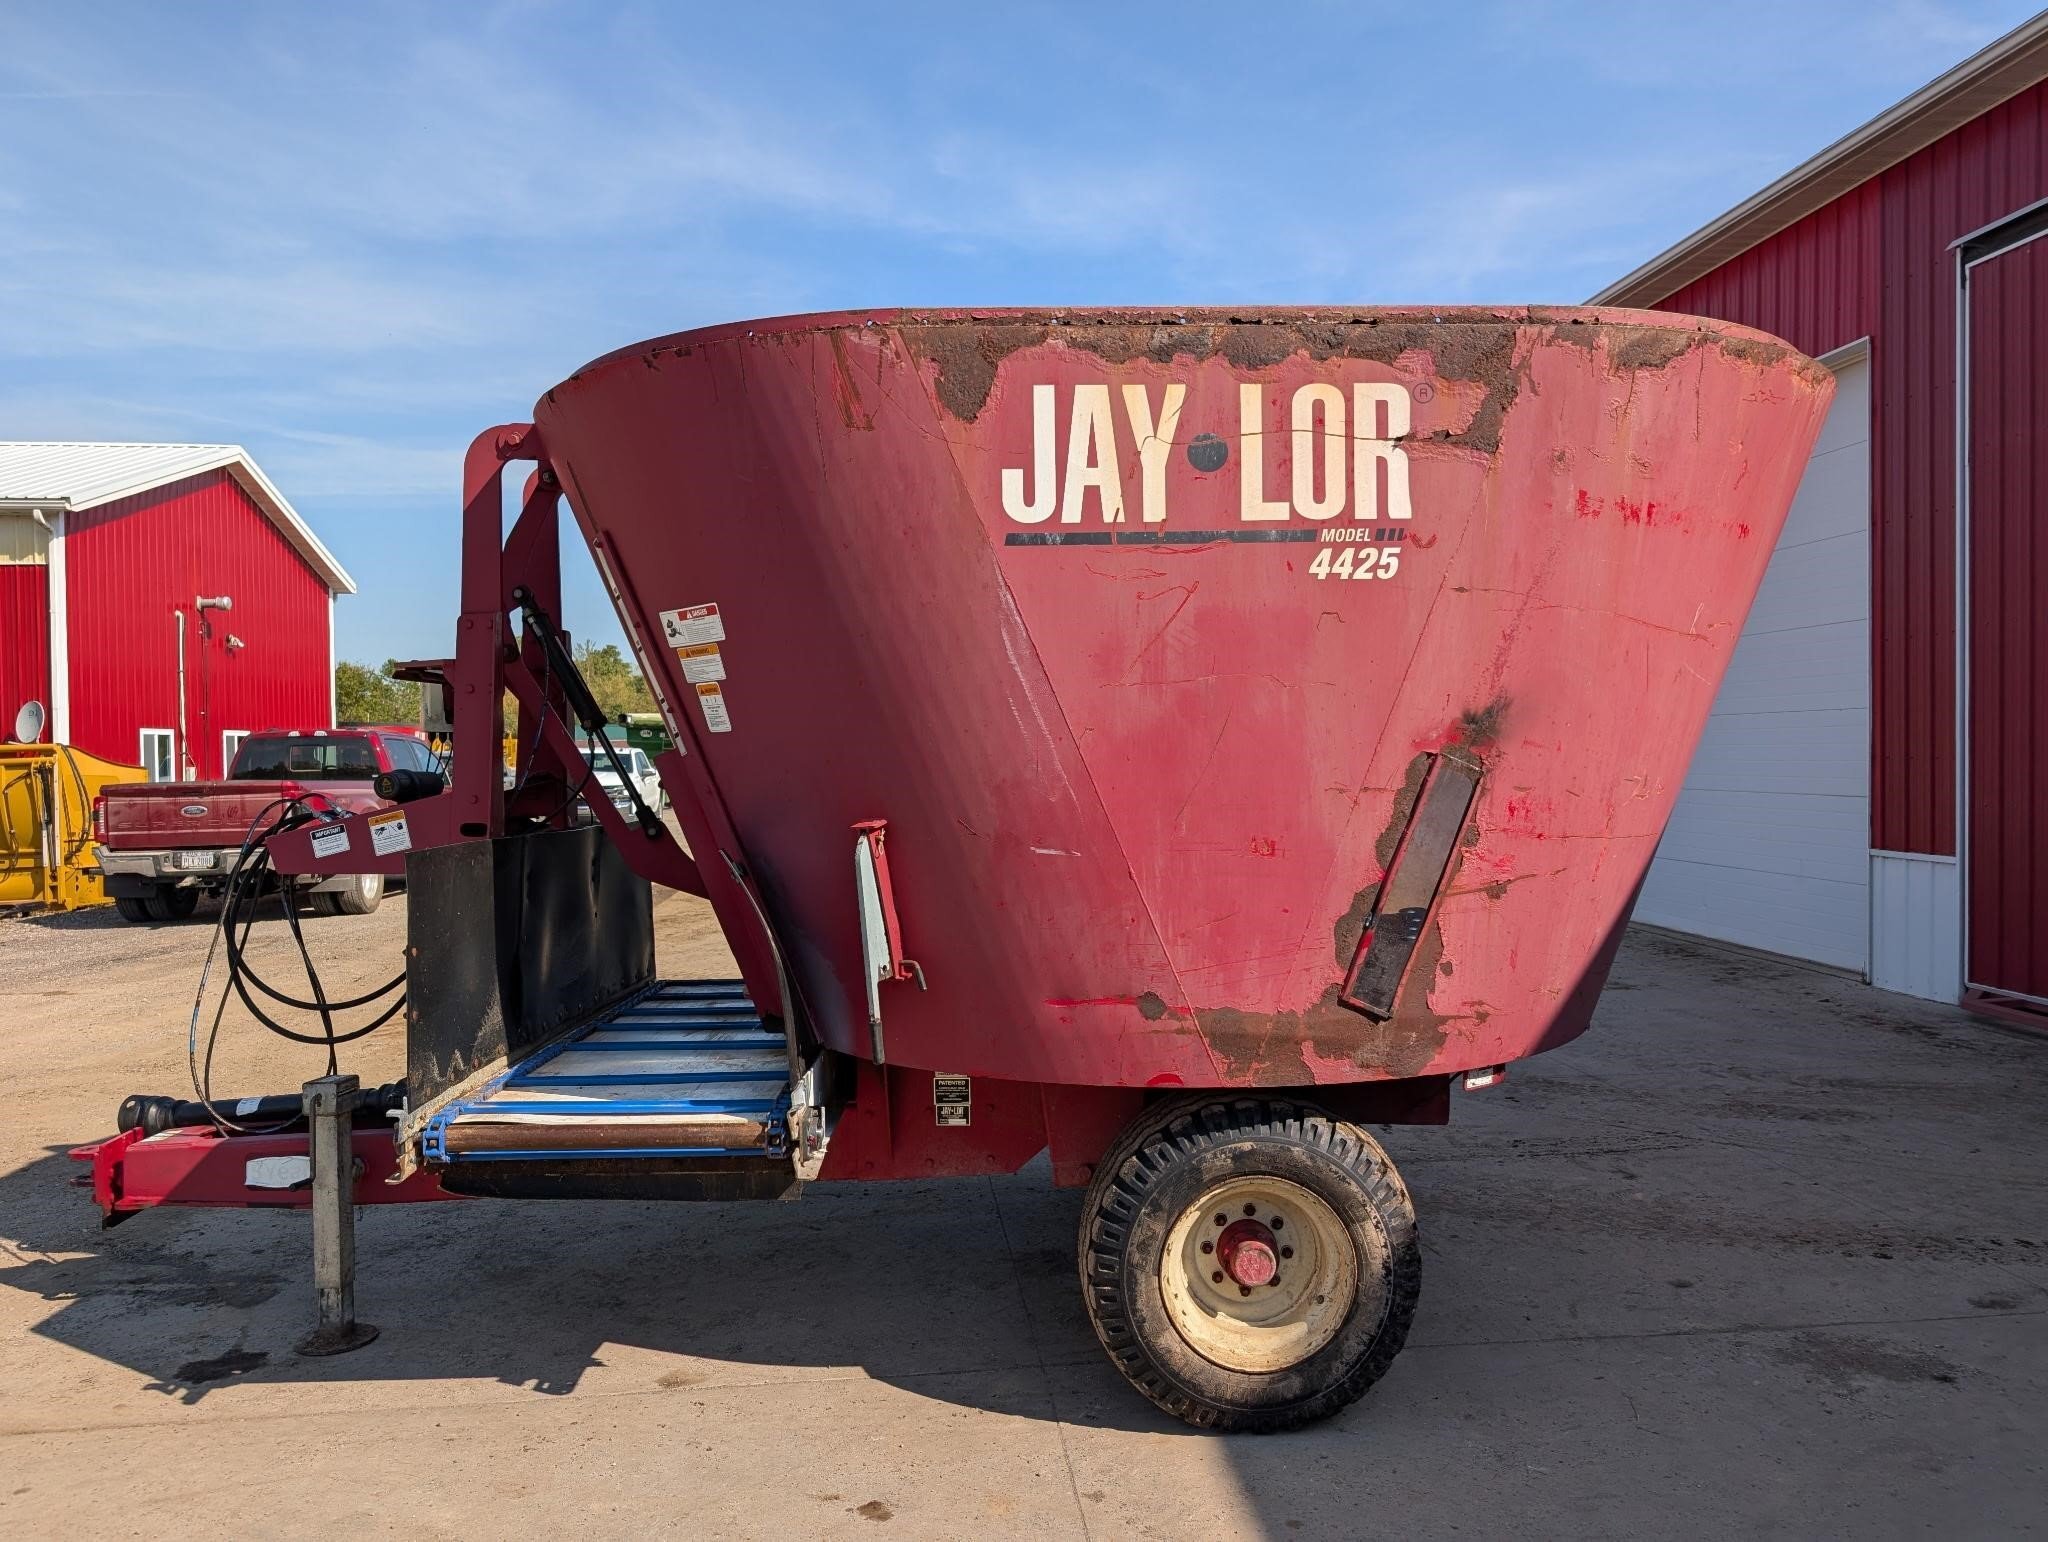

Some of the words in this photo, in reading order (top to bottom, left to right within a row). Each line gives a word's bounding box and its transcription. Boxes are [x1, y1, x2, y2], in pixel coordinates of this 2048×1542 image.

[1001, 383, 1186, 524] JAY
[1239, 382, 1413, 521] LOR
[1320, 527, 1371, 543] MODEL
[1308, 546, 1402, 580] 4425
[314, 826, 342, 839] IMPORTANT
